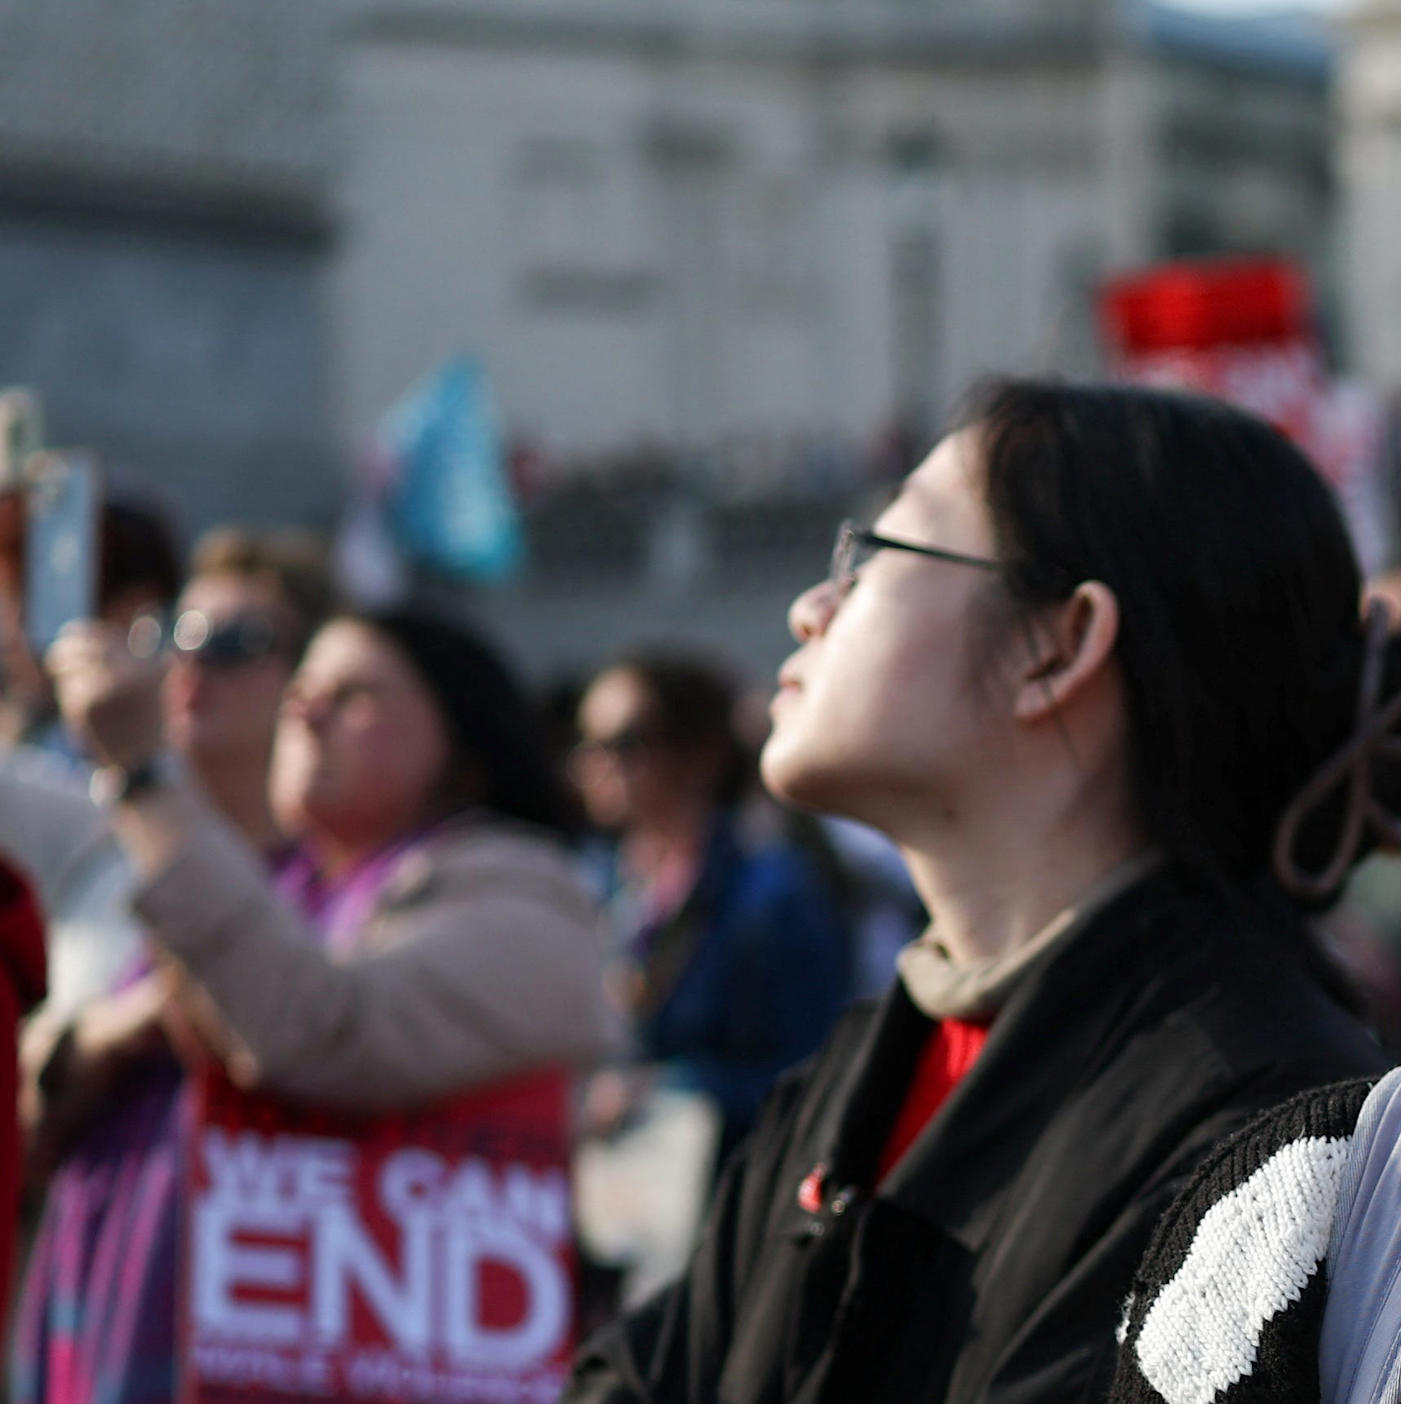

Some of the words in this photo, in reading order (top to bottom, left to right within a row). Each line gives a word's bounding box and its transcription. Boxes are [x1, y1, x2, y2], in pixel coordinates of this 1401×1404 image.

[203, 1130, 352, 1212] WE
[378, 1148, 566, 1238] CAN
[193, 1198, 574, 1376] END
